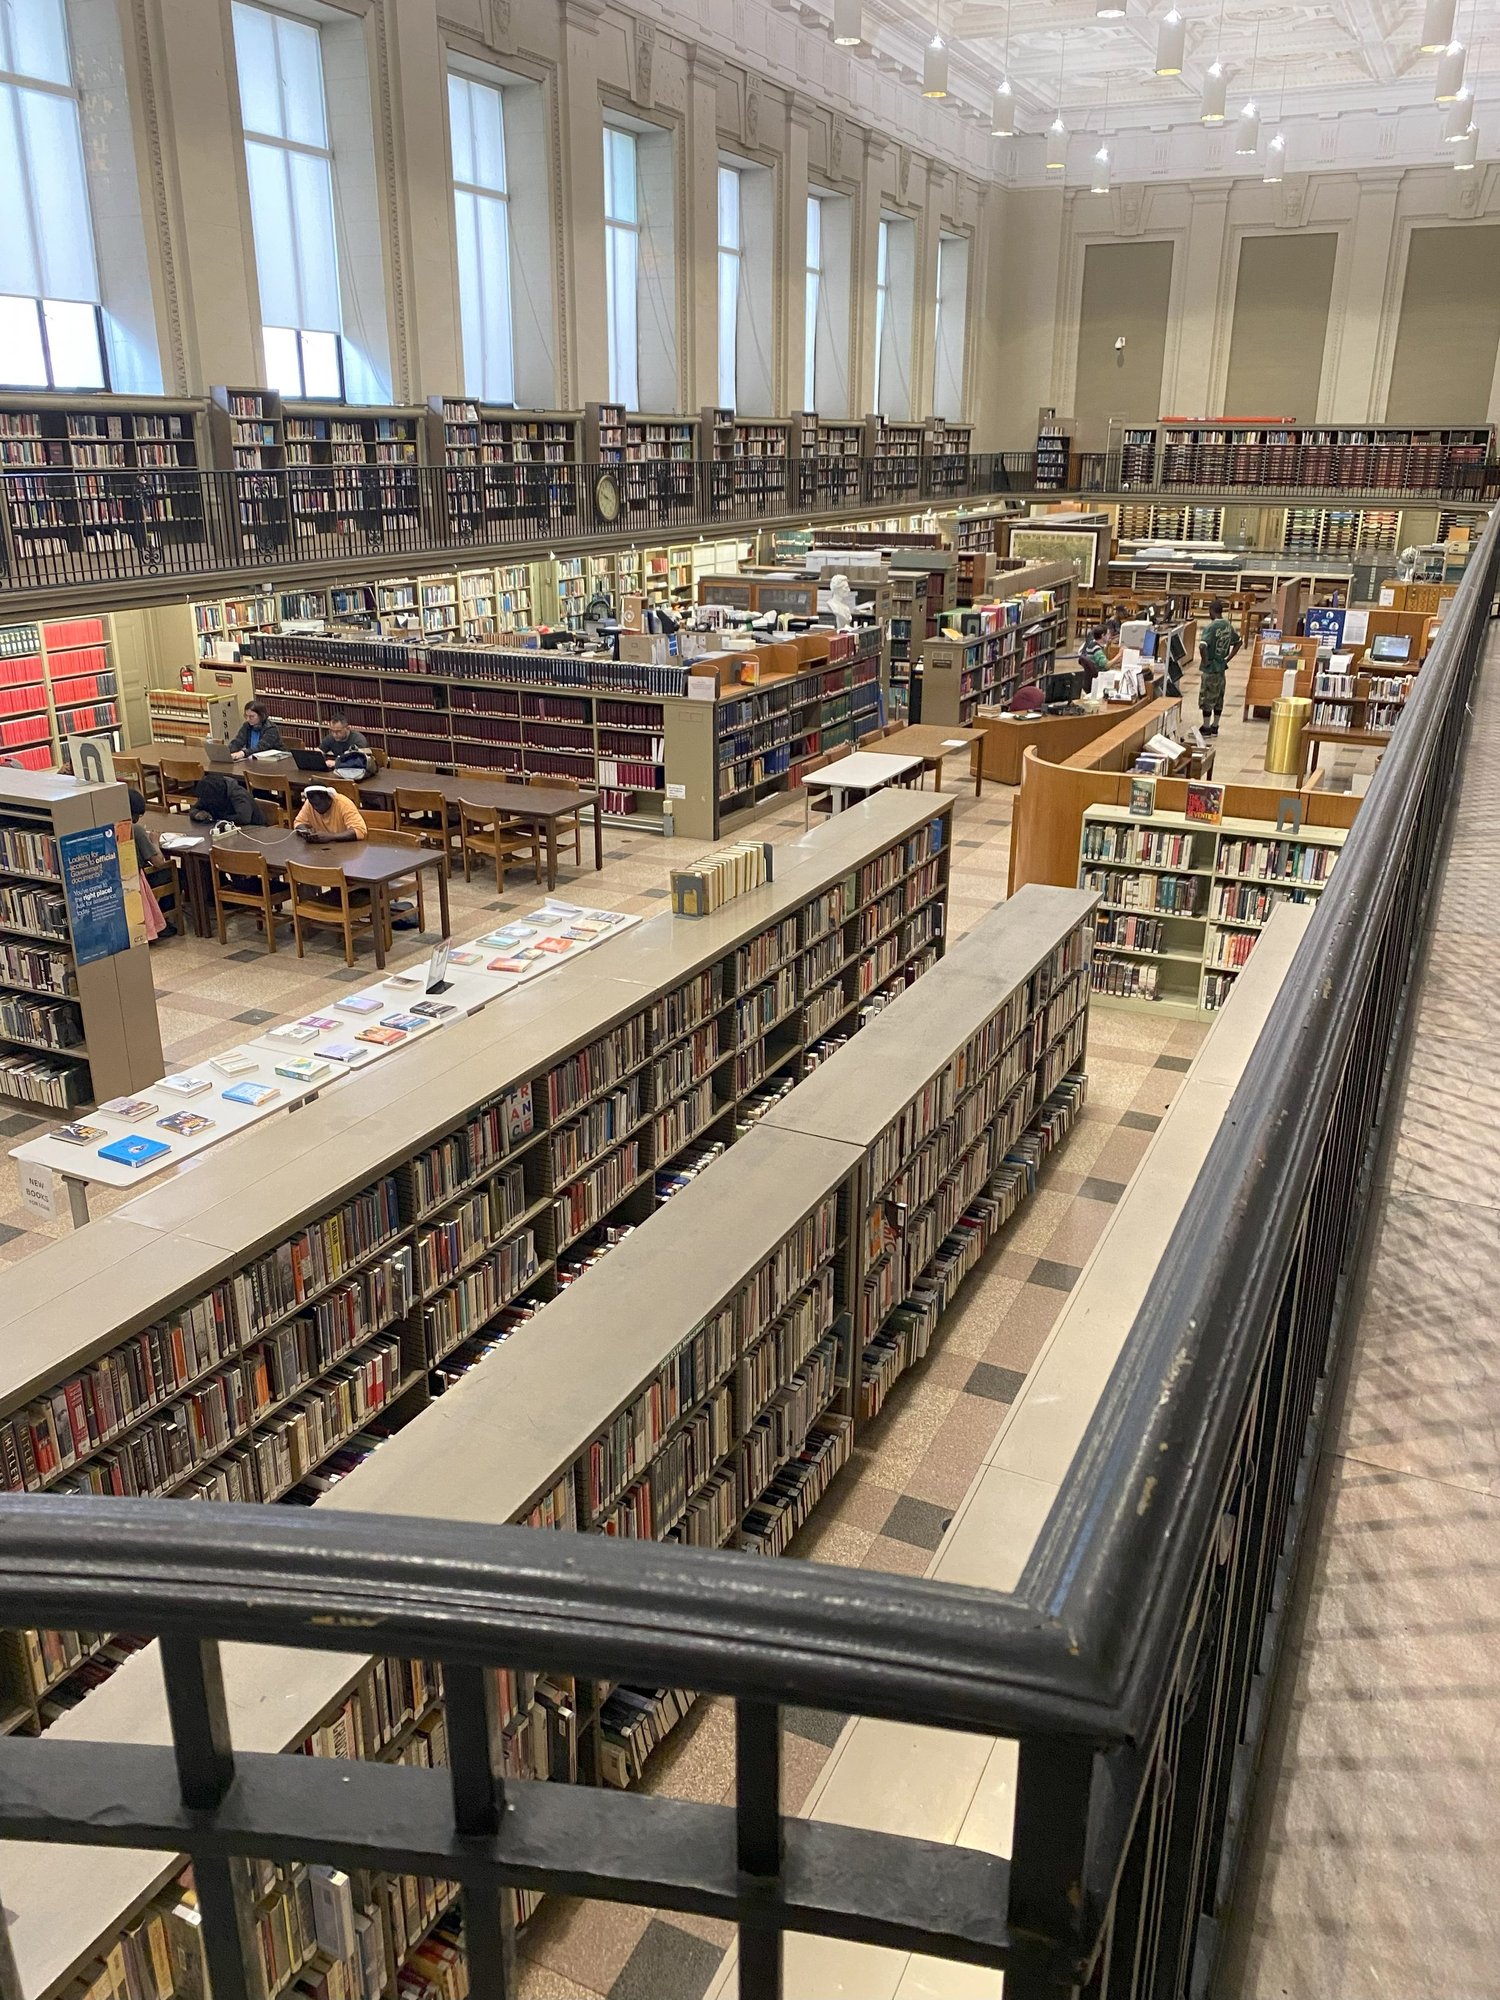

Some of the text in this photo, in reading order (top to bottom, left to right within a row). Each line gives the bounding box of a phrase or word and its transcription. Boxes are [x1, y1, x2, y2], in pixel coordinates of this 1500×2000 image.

[68, 853, 91, 865] Looking
[95, 852, 116, 864] official
[83, 890, 97, 902] right
[97, 886, 112, 898] place!
[29, 1177, 44, 1189] NEW
[26, 1188, 49, 1203] BOOKS
[19, 1426, 35, 1474] HITLER
[4, 1437, 20, 1484] HITLER
